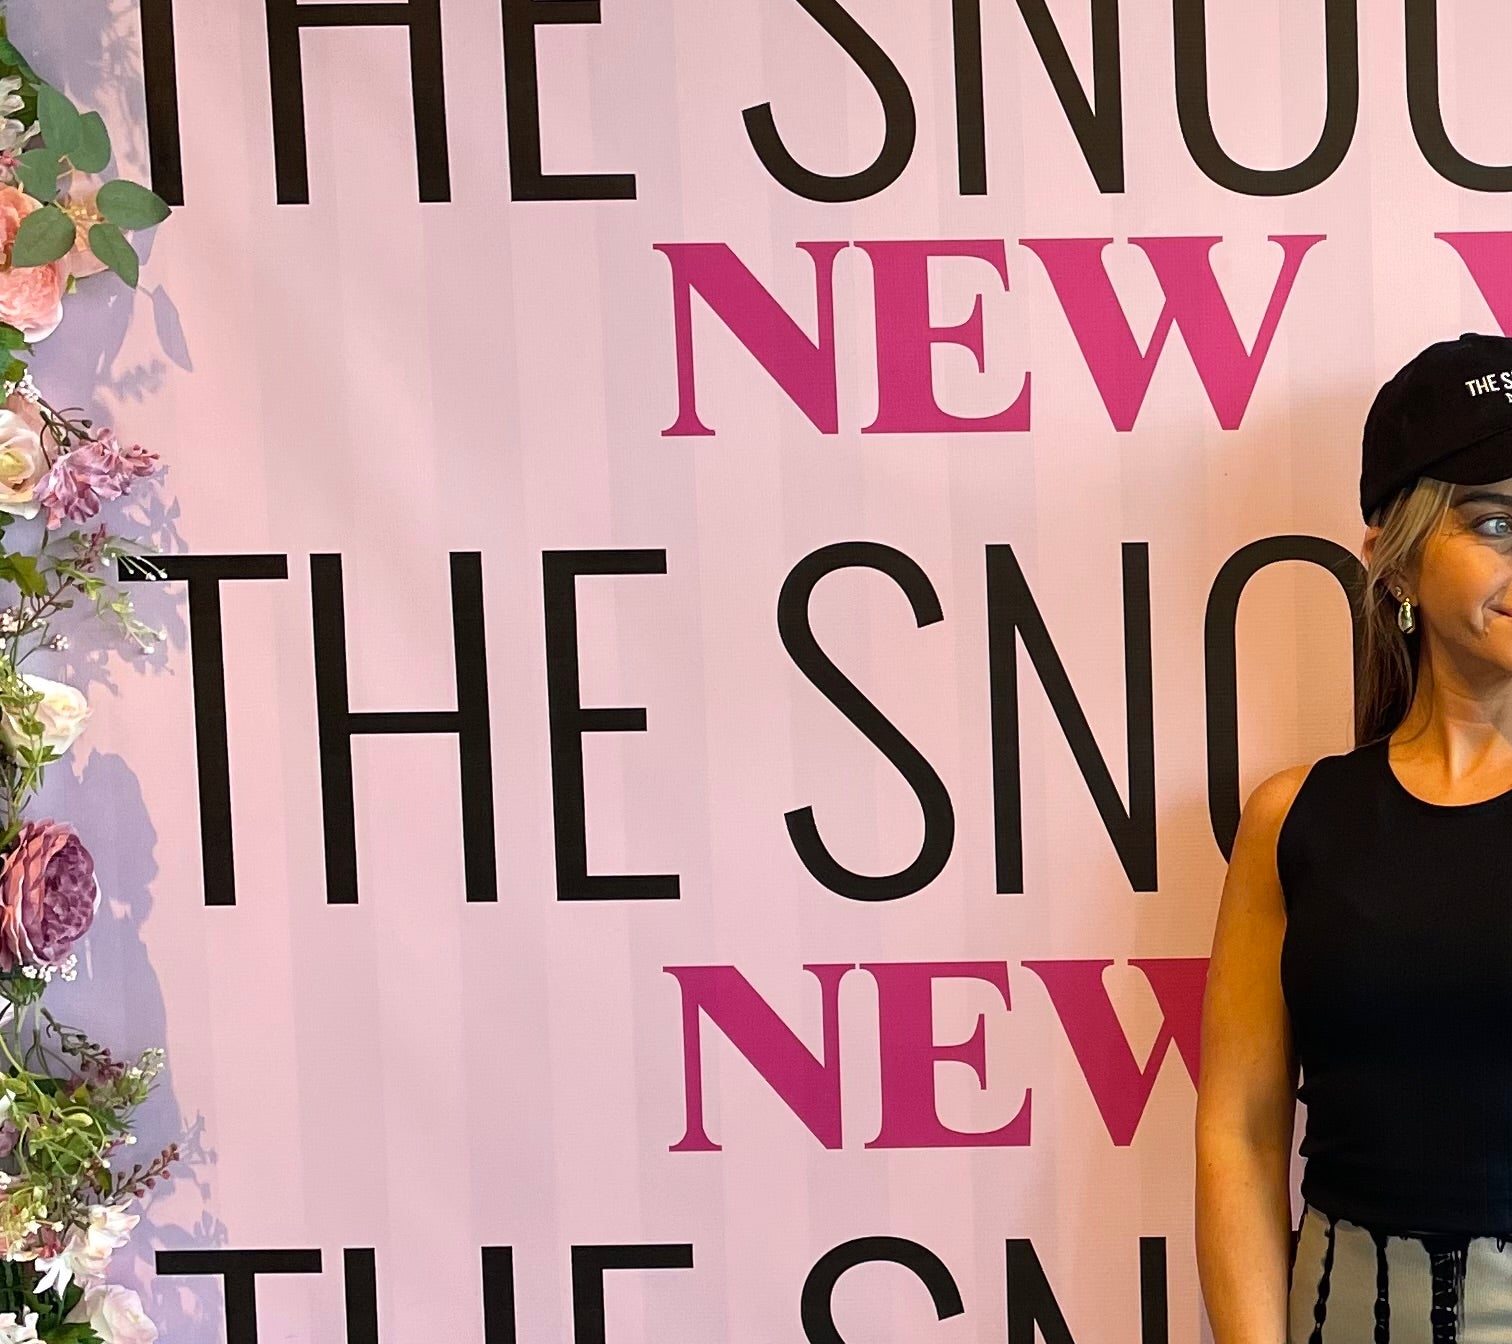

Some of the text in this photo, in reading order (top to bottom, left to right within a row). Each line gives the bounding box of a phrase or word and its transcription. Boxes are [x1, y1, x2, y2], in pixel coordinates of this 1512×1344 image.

[652, 234, 1327, 437] NEW
[1464, 373, 1500, 397] THE
[117, 548, 681, 907] THE
